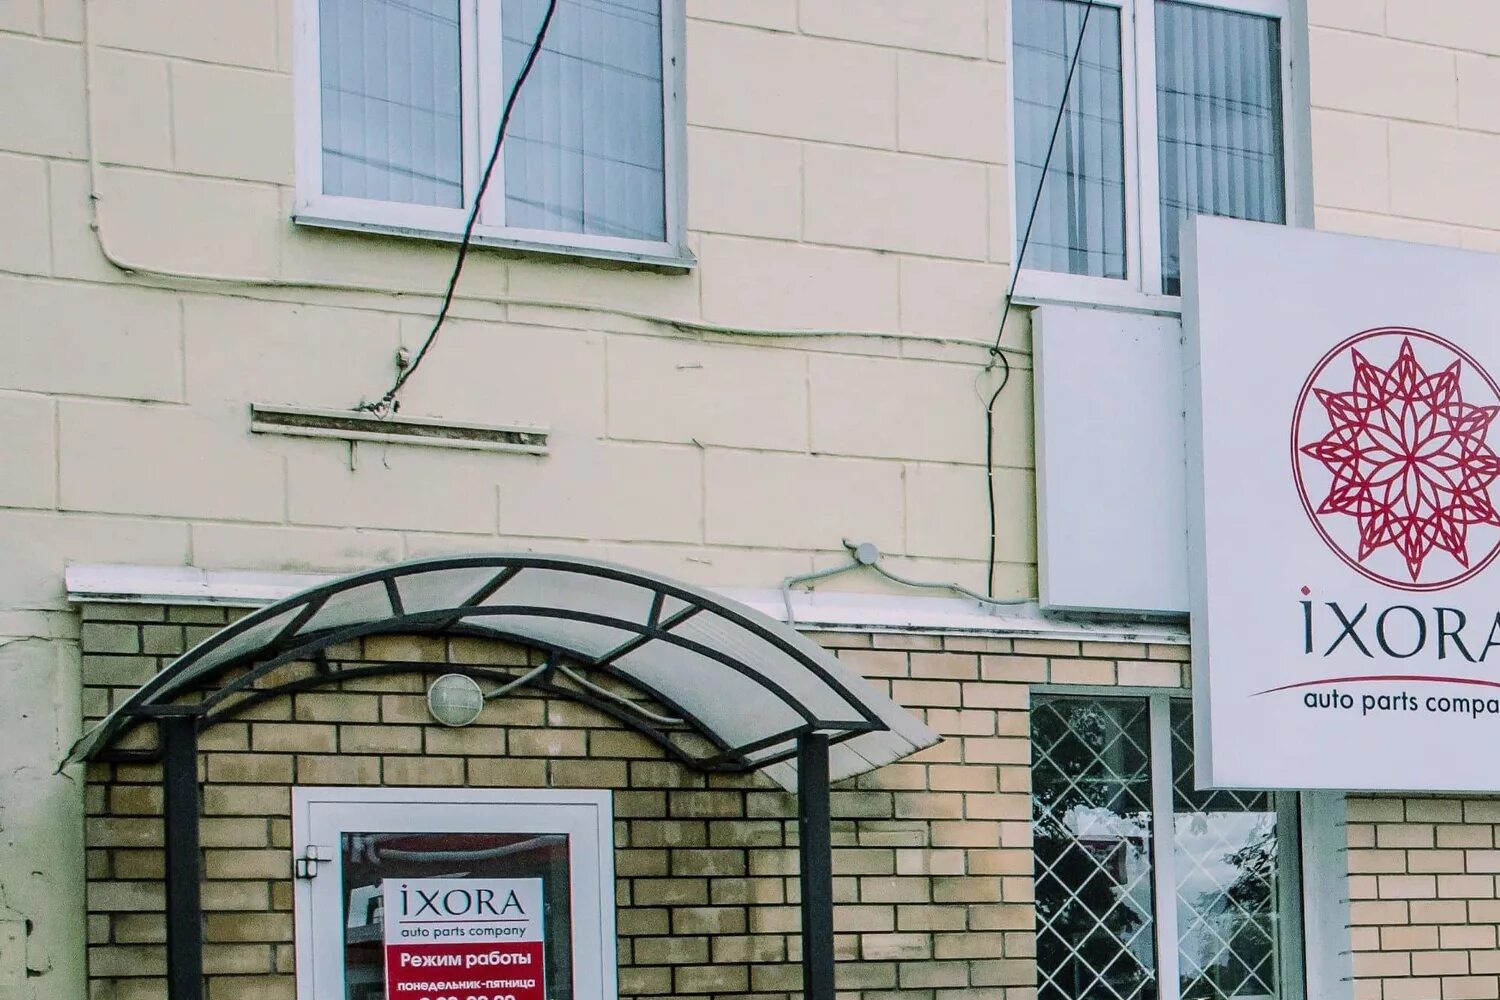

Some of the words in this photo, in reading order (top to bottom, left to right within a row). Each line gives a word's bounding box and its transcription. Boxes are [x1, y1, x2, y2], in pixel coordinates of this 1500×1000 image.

[1304, 689, 1353, 709] auto
[1362, 691, 1418, 716] parts
[401, 926, 430, 938] auto
[434, 926, 465, 940] parts
[469, 925, 527, 939] company
[401, 952, 462, 968] Режим
[466, 950, 532, 969] работы
[397, 977, 536, 992] понедельник-пятница
